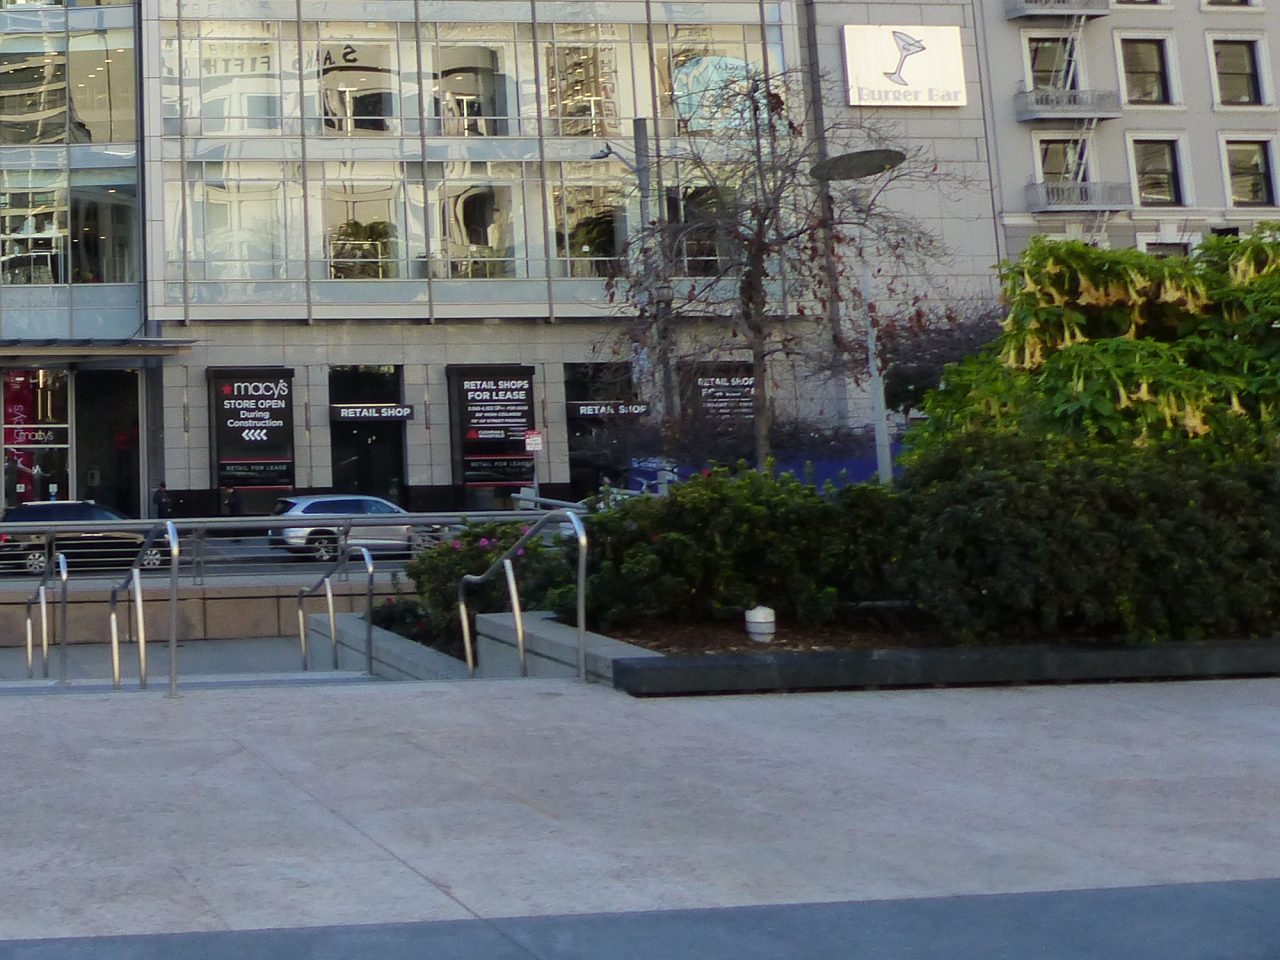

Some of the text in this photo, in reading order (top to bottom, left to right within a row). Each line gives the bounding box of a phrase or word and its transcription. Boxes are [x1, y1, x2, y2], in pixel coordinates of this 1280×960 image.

[858, 87, 962, 102] Burger Bar
[234, 379, 289, 399] macy's
[464, 380, 529, 390] RETAIL SHOPS
[468, 391, 527, 400] FOR LEASE
[223, 400, 286, 409] STORE OPEN
[240, 410, 270, 419] During
[341, 408, 411, 417] RETAIL SHOP
[226, 419, 284, 427] Construction
